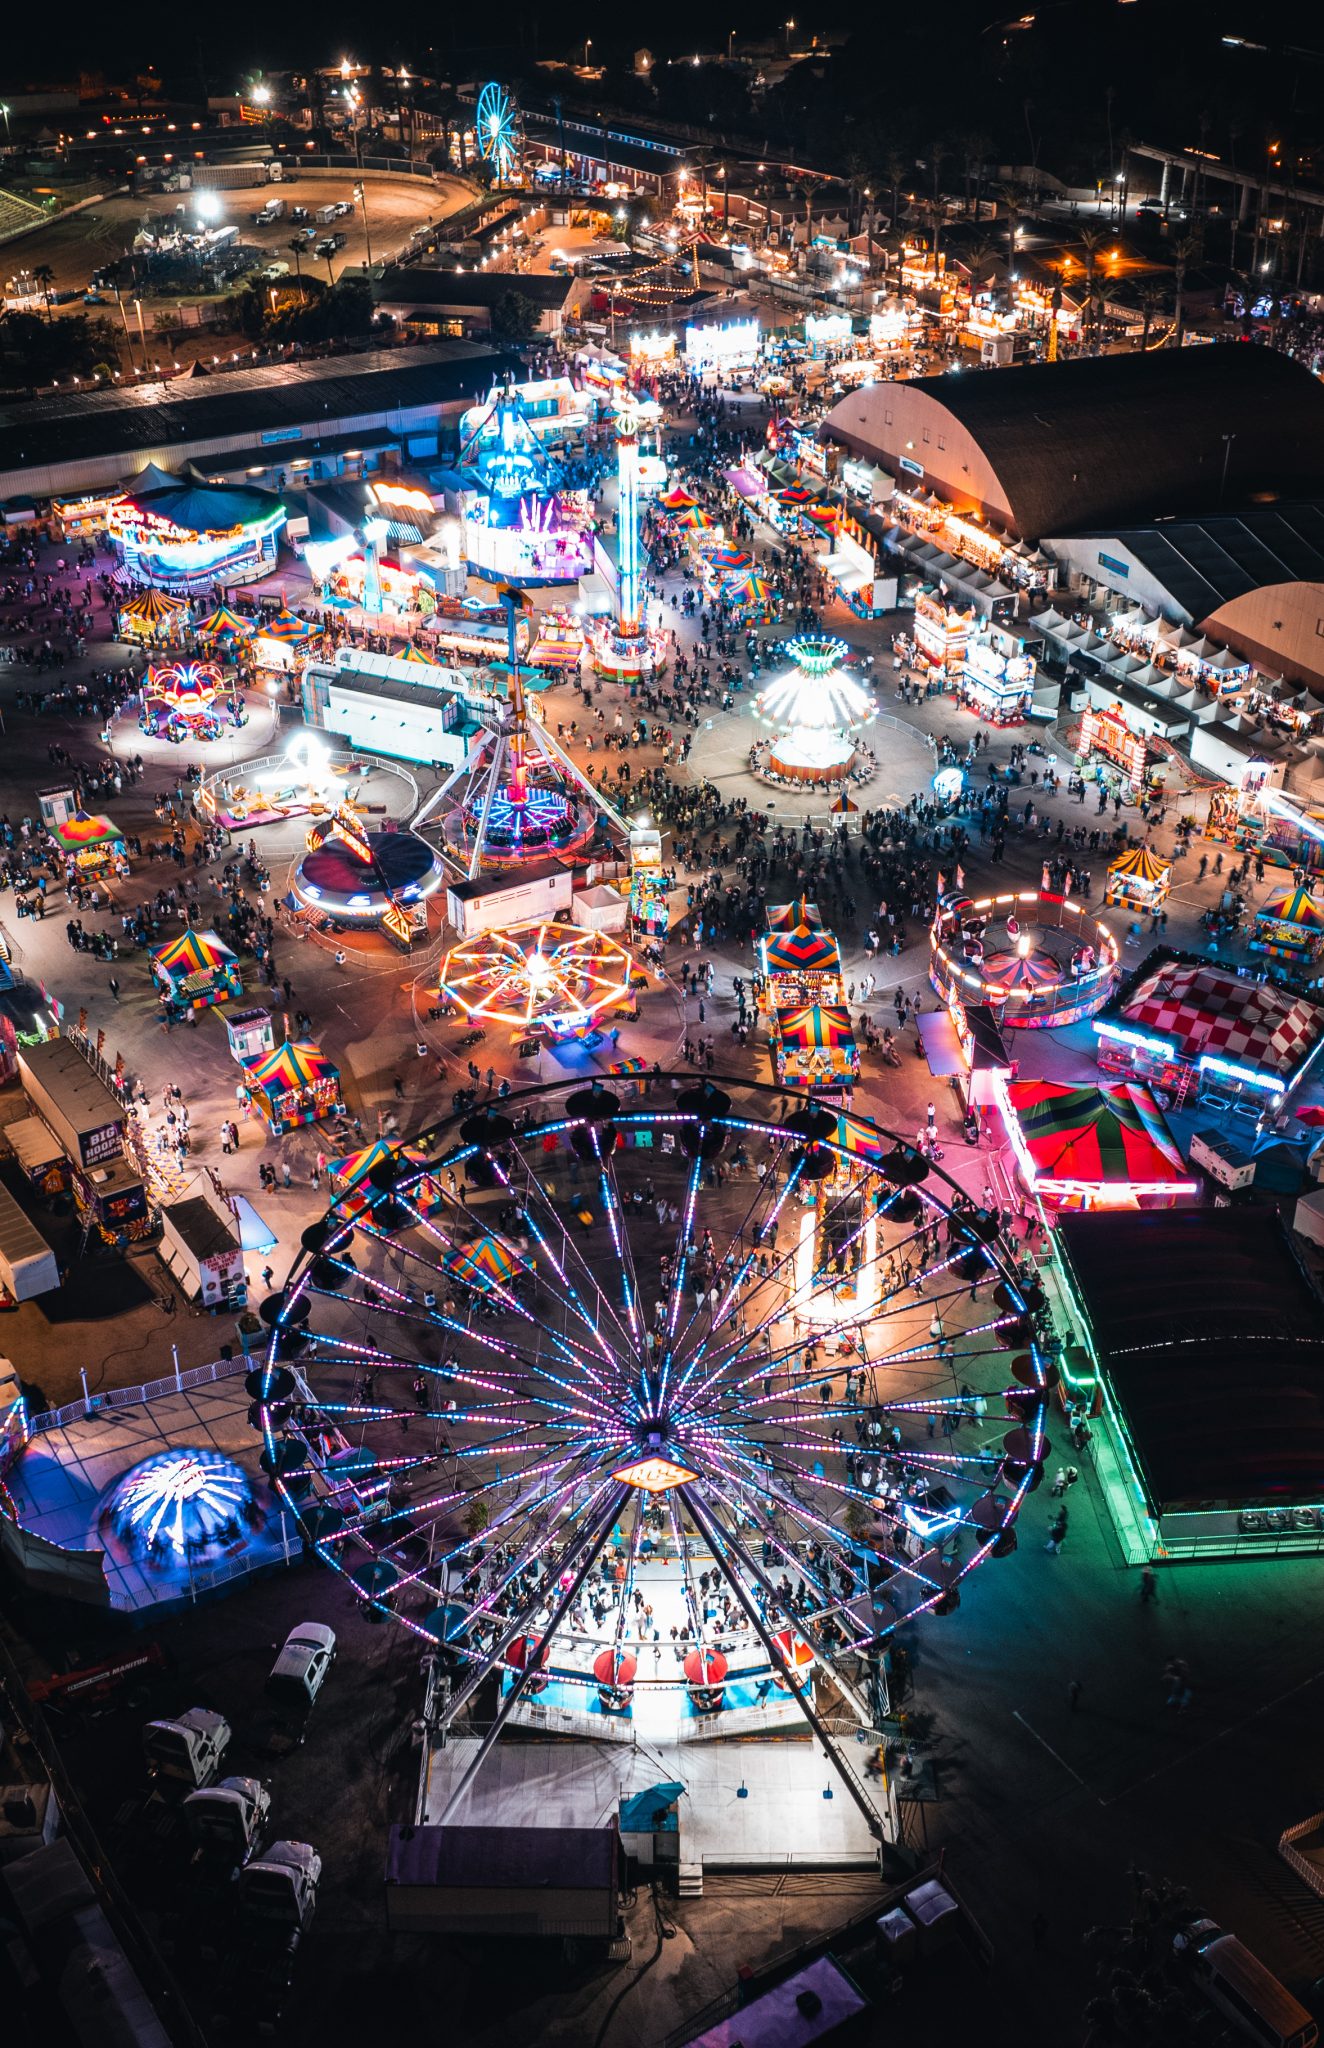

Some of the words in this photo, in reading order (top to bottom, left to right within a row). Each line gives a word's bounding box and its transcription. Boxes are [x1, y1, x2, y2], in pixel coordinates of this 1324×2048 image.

[86, 1134, 123, 1159] HOOPS
[90, 1127, 115, 1146] BIG
[112, 1656, 149, 1676] MANITOU
